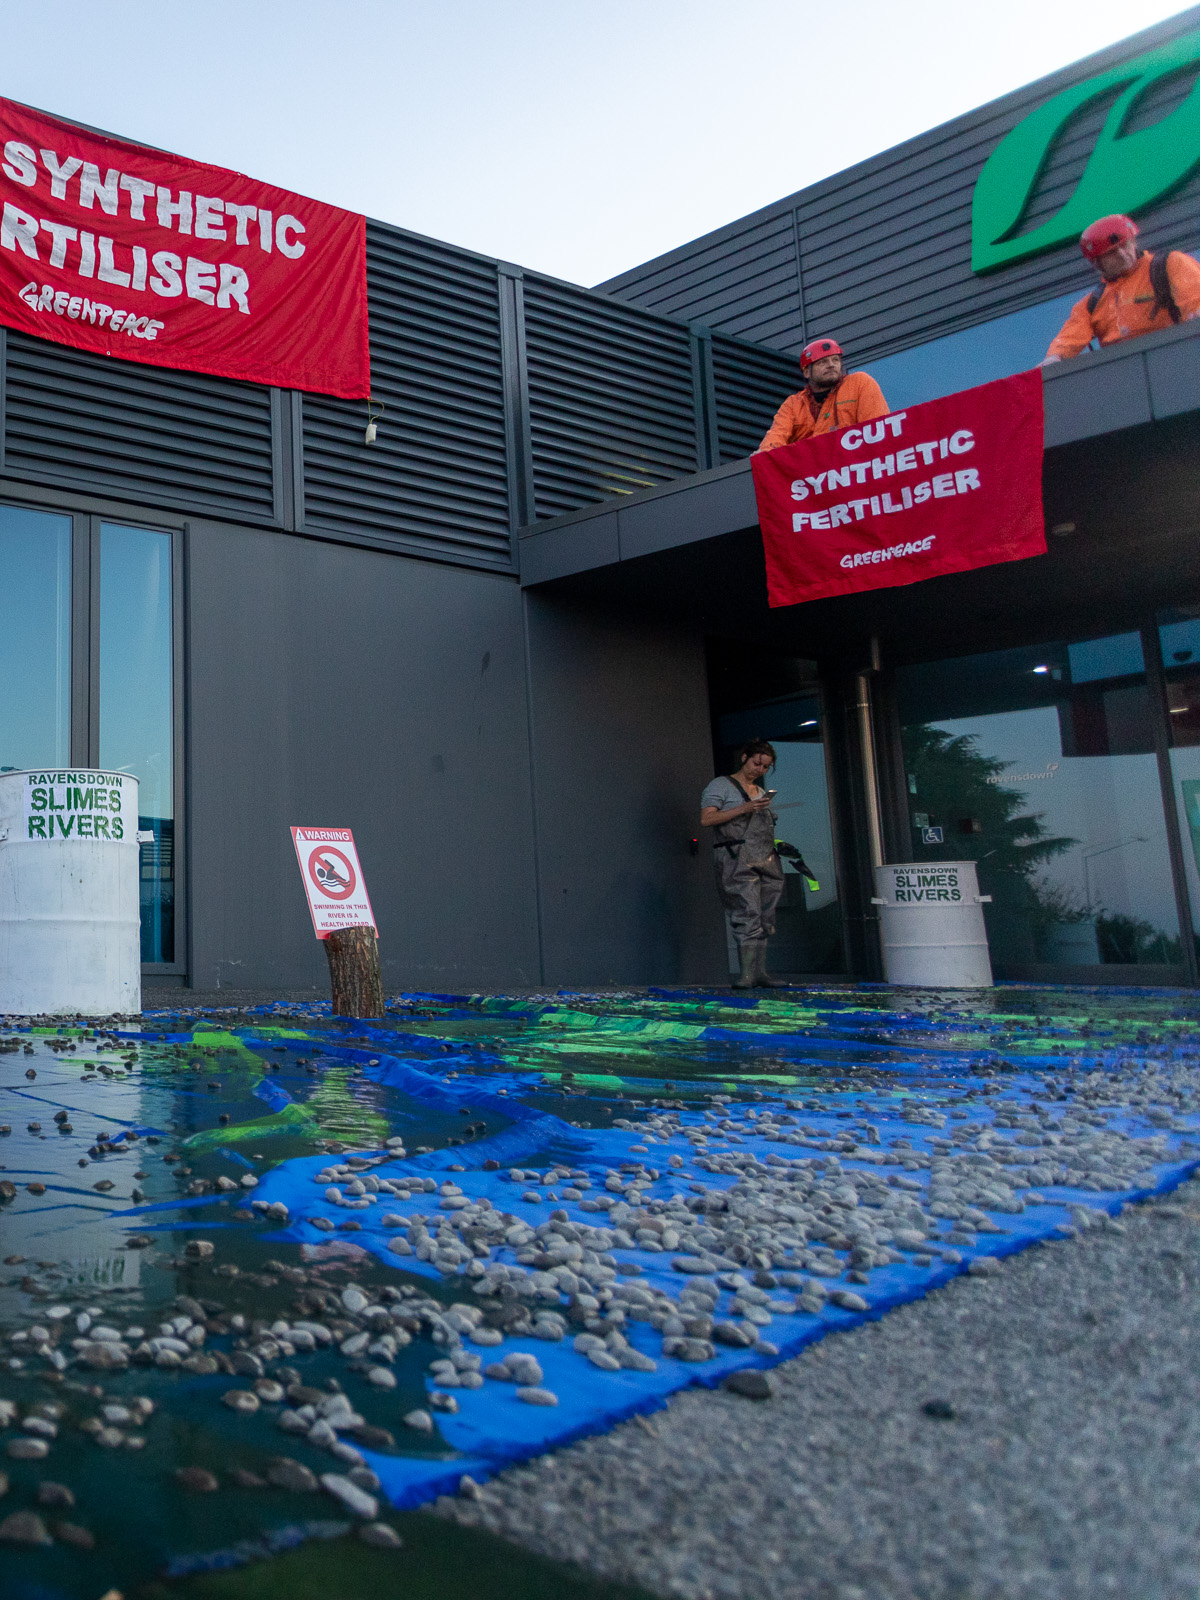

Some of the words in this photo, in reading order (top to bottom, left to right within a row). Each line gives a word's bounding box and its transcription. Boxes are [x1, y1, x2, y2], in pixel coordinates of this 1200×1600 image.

[2, 140, 306, 260] SYNTHETIC
[18, 281, 165, 341] GREENPEACE
[840, 412, 907, 451] CUT
[790, 430, 976, 502] SYNTHETIC
[791, 467, 981, 533] FERTILISER
[28, 773, 123, 787] RAVENSDOWN
[30, 787, 121, 813] SLIMES
[28, 814, 124, 840] RIVERS
[305, 830, 349, 840] WARNING
[893, 867, 958, 875] RAVENSDOWN
[896, 874, 958, 888] SLIMES
[895, 888, 961, 902] RIVERS
